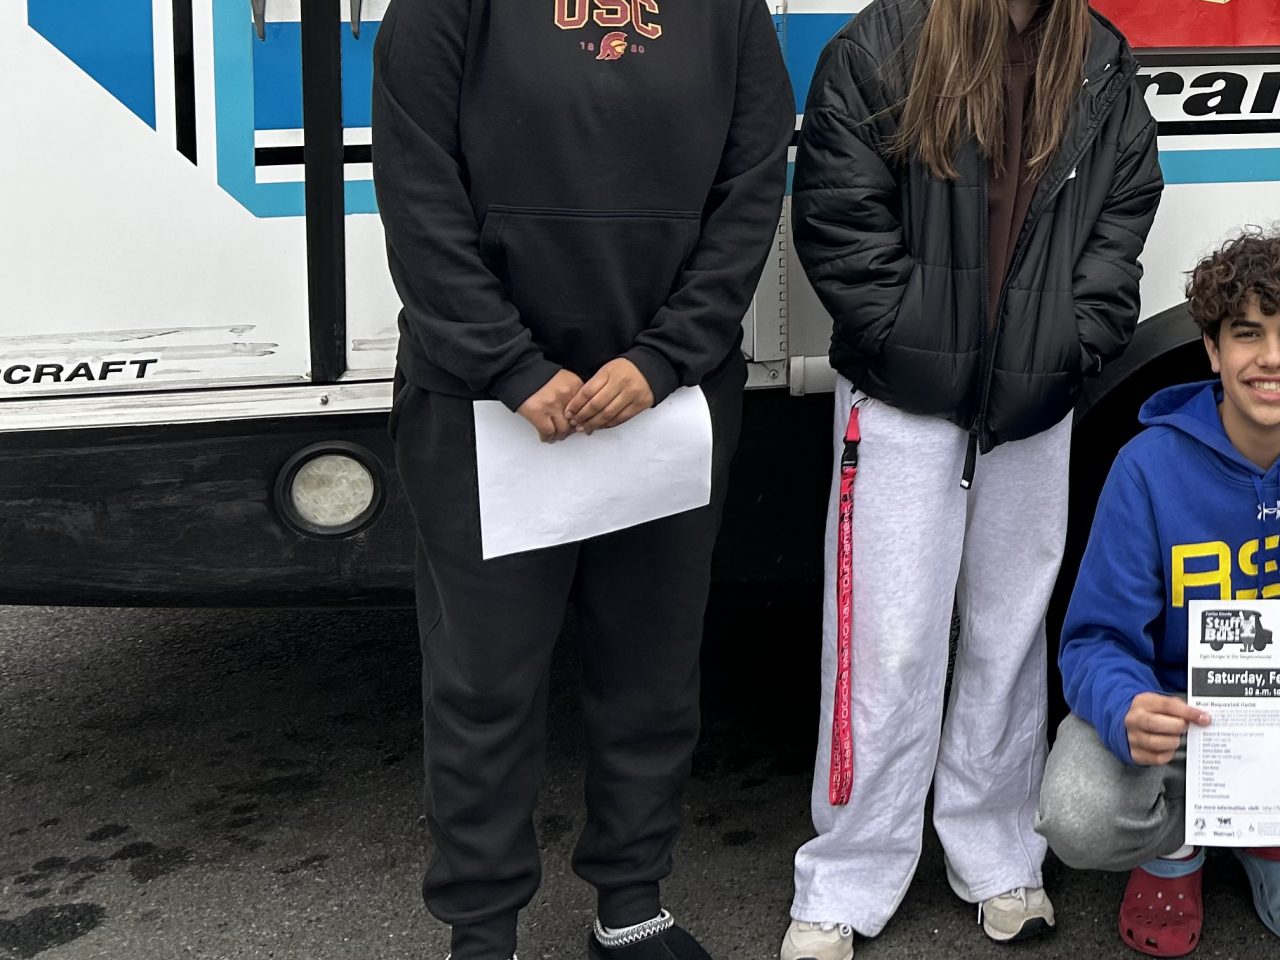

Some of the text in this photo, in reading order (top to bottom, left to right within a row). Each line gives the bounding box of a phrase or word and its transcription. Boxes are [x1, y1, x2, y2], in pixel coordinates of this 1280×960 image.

[579, 41, 645, 54] 18 80
[0, 358, 158, 385] CRAFT
[1205, 616, 1241, 629] Stuff
[1204, 628, 1240, 642] Bus!
[1207, 670, 1266, 687] Saturday,
[1244, 687, 1253, 696] 10
[1255, 688, 1272, 696] a.m.
